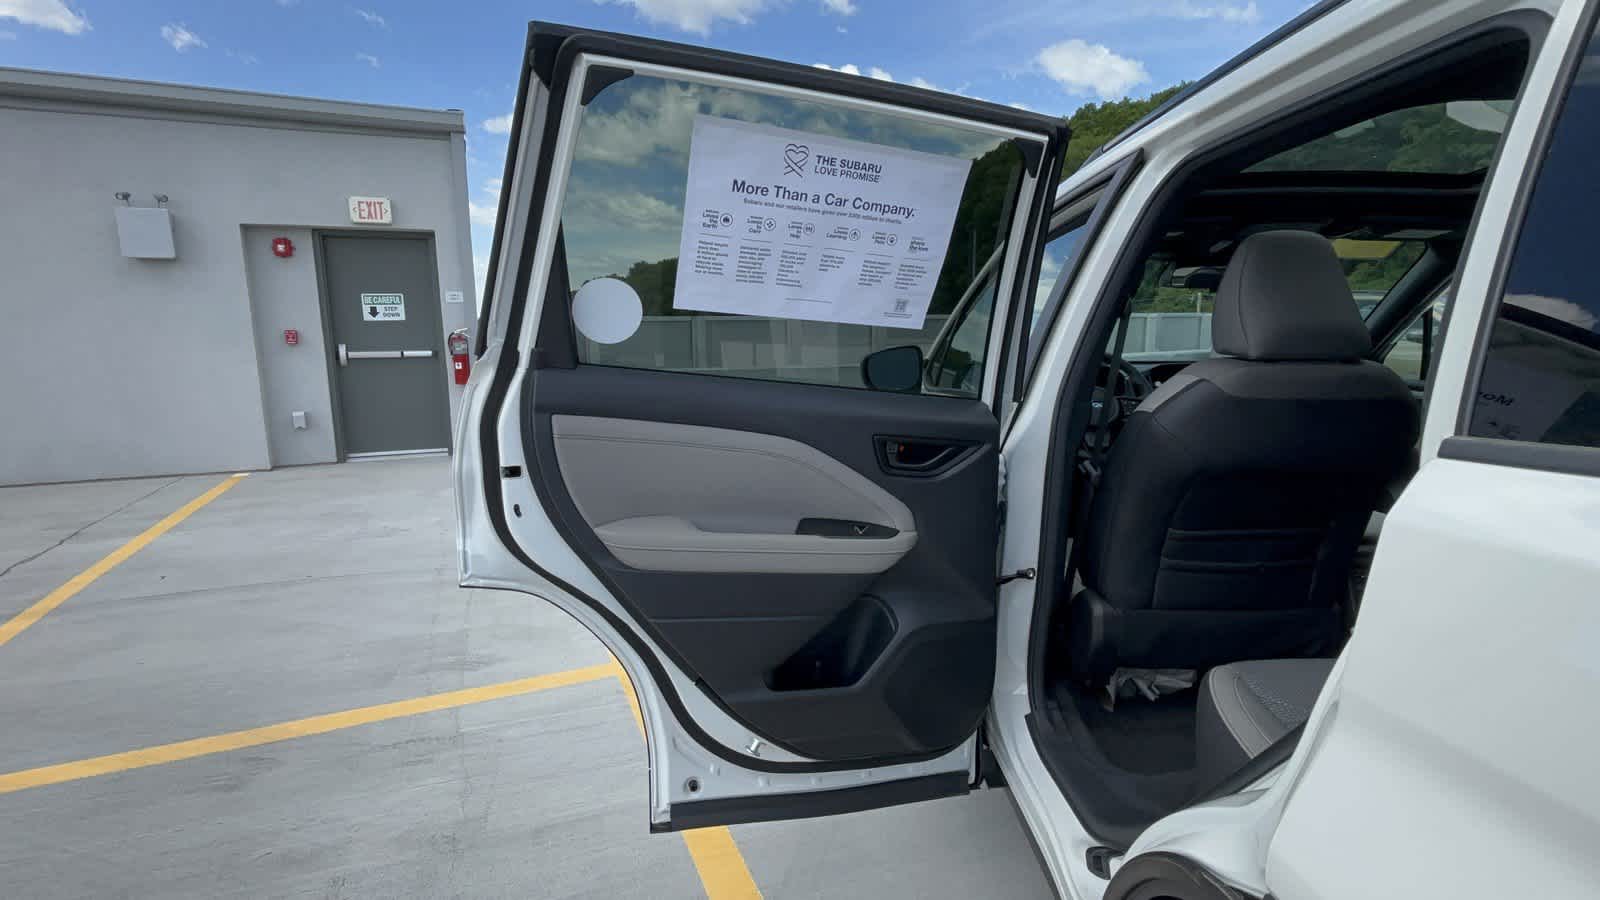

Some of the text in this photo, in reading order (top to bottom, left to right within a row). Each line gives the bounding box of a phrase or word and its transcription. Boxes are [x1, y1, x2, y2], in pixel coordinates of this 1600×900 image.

[815, 155, 882, 174] THE SUBARU
[814, 166, 880, 183] LOVE PROMISE
[732, 179, 769, 197] More
[774, 185, 808, 202] Than
[812, 194, 820, 204] a
[825, 193, 849, 208] Car
[853, 197, 915, 219] Company.
[357, 200, 385, 221] EXIT
[364, 296, 402, 304] BE CAREFUL
